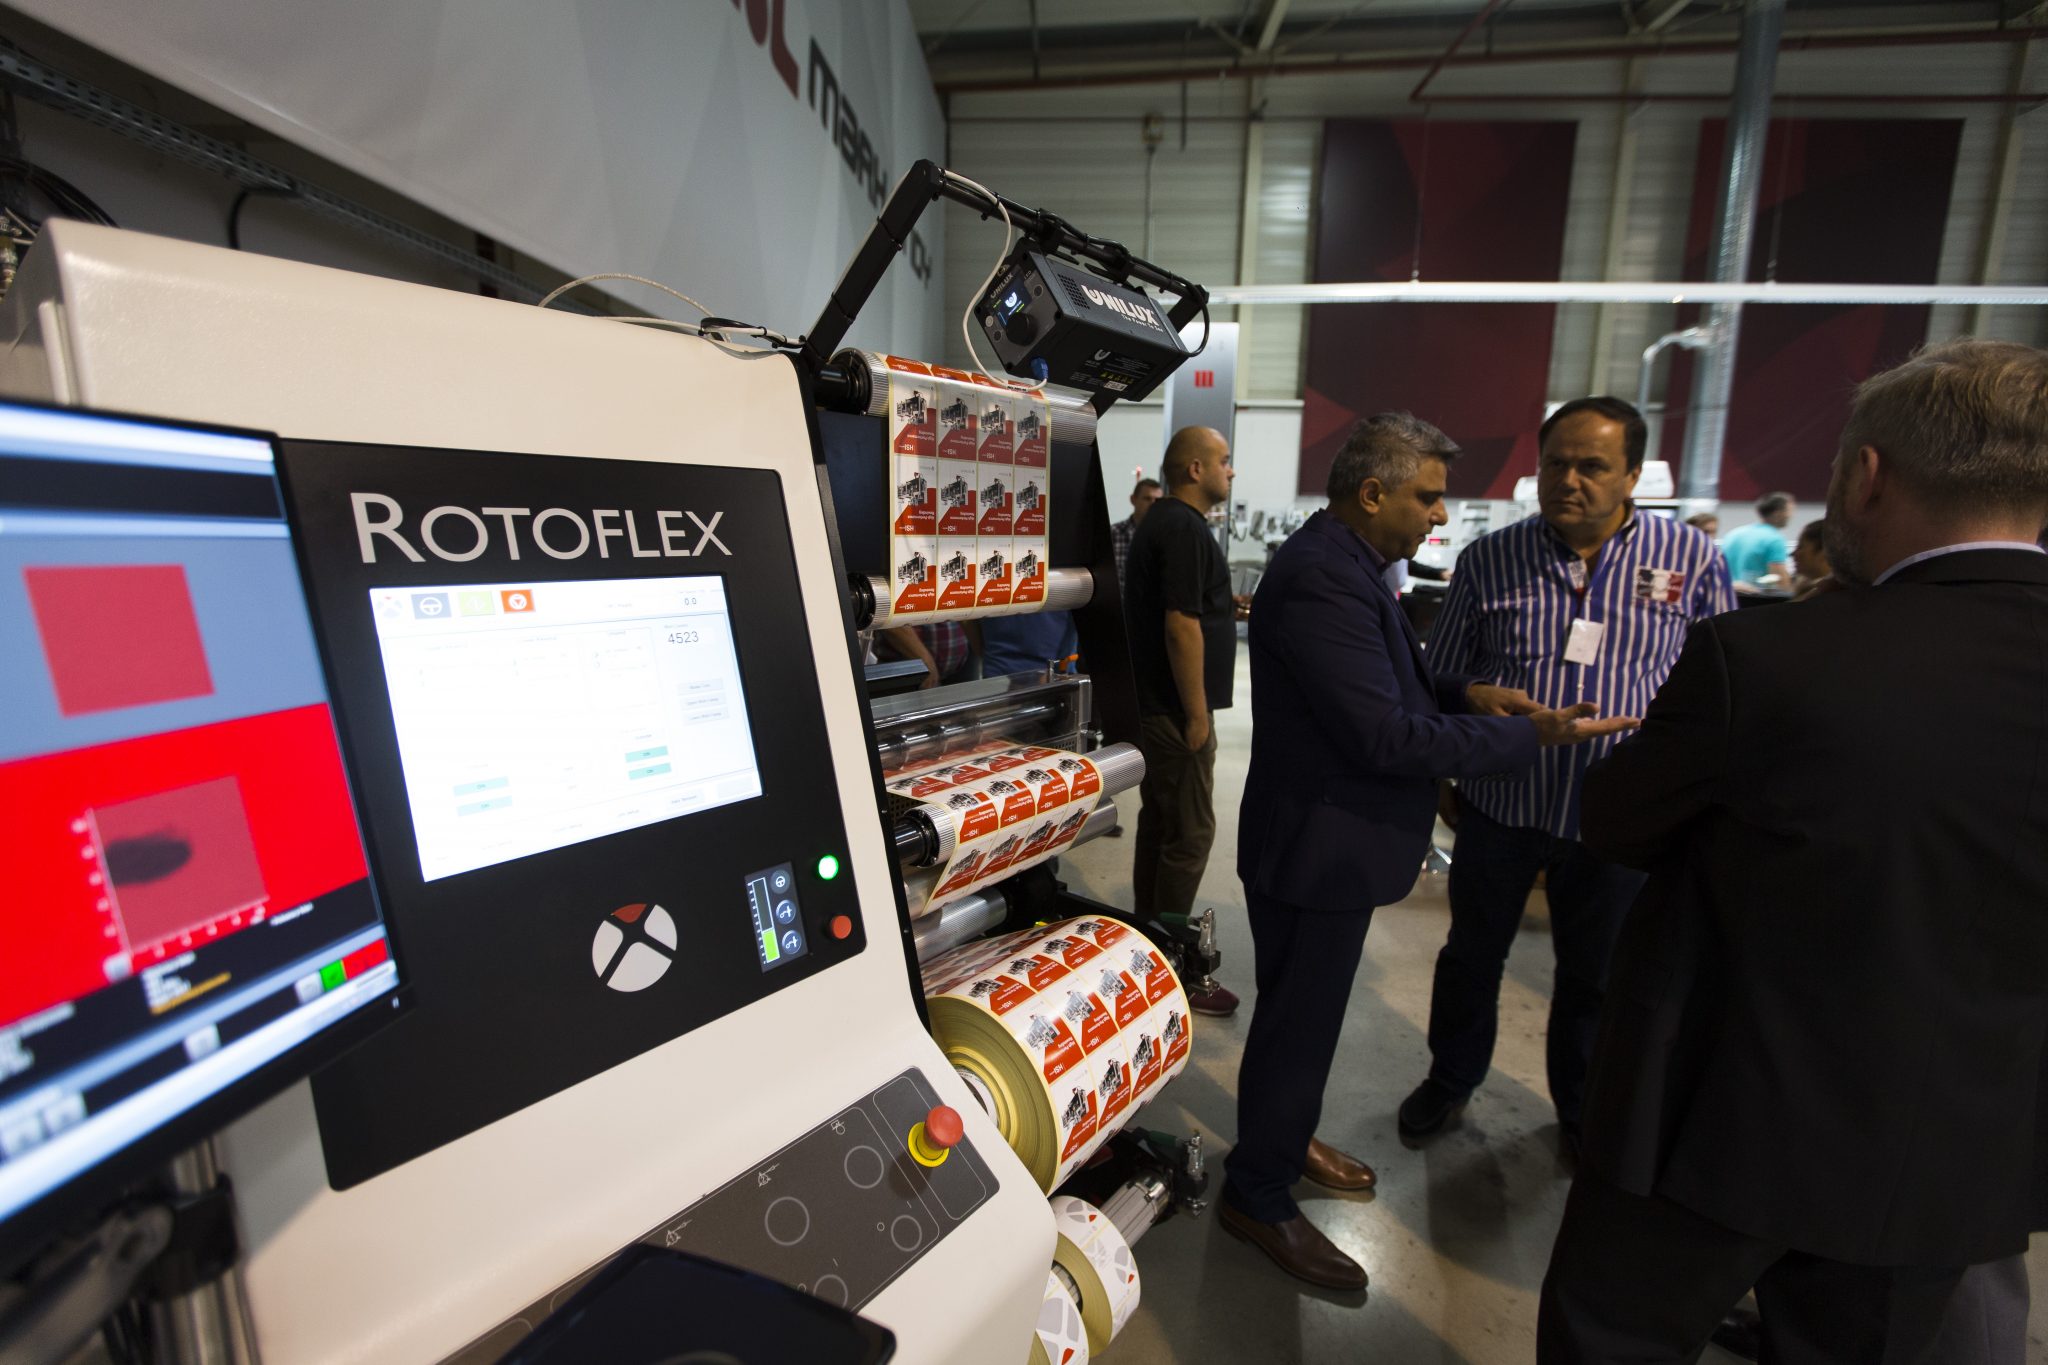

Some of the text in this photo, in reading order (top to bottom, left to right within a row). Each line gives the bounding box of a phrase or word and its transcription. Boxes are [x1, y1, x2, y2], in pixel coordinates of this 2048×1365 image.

[1081, 285, 1159, 326] UNILUX
[350, 492, 732, 563] ROTOFLEX
[668, 631, 699, 644] 4523
